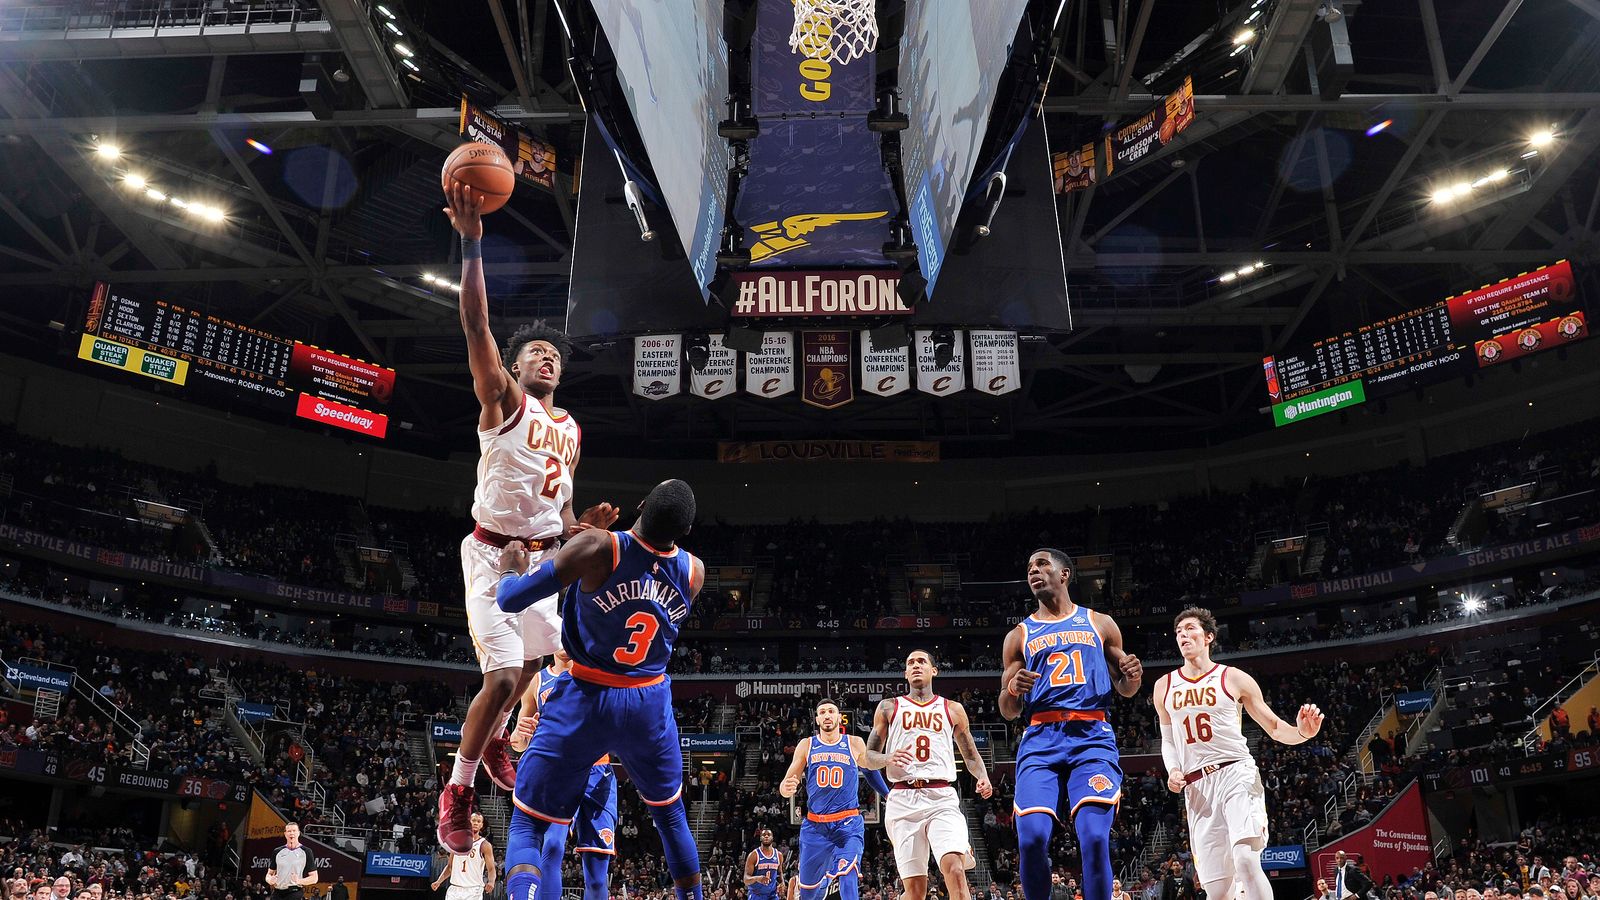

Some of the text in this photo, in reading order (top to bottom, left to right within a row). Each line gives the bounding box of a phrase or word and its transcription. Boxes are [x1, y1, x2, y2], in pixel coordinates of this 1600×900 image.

[797, 0, 832, 101] GOOD
[1123, 122, 1154, 145] ALL-STAR
[1117, 130, 1160, 160] CLARKSON'S
[1129, 146, 1151, 162] CREW
[916, 184, 940, 277] FirstEnergy
[1486, 286, 1513, 299] REQUIRE
[1513, 274, 1550, 290] ASSISTANCE
[120, 298, 140, 308] OSMAN
[1474, 306, 1488, 315] TEXT
[1523, 290, 1541, 299] TEAM
[119, 305, 134, 314] HOOD
[117, 312, 139, 323] SEXTON
[1490, 312, 1510, 322] TWEET
[114, 326, 132, 336] NANCE
[116, 319, 145, 332] CLARKSON
[119, 336, 140, 346] TOTALS
[641, 340, 675, 348] 2006-07
[763, 337, 787, 345] 15-16
[974, 340, 1015, 348] CHAMPIONS
[94, 342, 128, 354] QUAKER
[708, 350, 729, 358] STERN
[756, 347, 785, 355] ASTERN
[819, 346, 835, 354] NBA
[100, 350, 123, 360] STEAK
[104, 357, 120, 365] LUBE
[642, 351, 673, 359] EASTERN
[749, 356, 792, 365] CONFERENCE
[806, 354, 848, 363] CHAMPIONS
[864, 355, 906, 363] CONFERENCE
[144, 355, 175, 368] QUAKER
[316, 354, 328, 362] YOU
[327, 358, 349, 369] REQUIRE
[349, 364, 380, 378] ASSISTANCE
[636, 359, 678, 368] CONFERENCE
[707, 358, 735, 367] FERENCE
[1287, 361, 1306, 371] KANTER
[1410, 359, 1438, 373] RODNEY
[1439, 353, 1460, 365] HOOD
[149, 364, 171, 373] STEAK
[153, 370, 169, 378] LUBE
[637, 368, 676, 377] CHAMPIONS
[750, 366, 790, 375] CHAMPIONS
[866, 364, 905, 373] CHAMPIONS
[312, 365, 367, 385] TEXT THE TEAM
[238, 379, 265, 392] RODNEY
[266, 387, 286, 397] HOOD
[321, 379, 339, 389] TWEET
[1297, 390, 1353, 414] Huntington
[527, 419, 575, 466] CAVS
[759, 442, 886, 461] LOUDVILLE
[540, 457, 562, 500] 2
[66, 543, 92, 560] ALE
[1467, 542, 1542, 567] SCH-STYLE
[1546, 533, 1571, 550] ALE
[277, 585, 345, 606] SCH-STYLE
[348, 597, 372, 608] ALE
[592, 579, 687, 626] HARDAWAY JR
[1152, 606, 1167, 614] BKN
[747, 619, 763, 630] 101
[788, 620, 801, 629] 22
[816, 619, 840, 629] 4:45
[853, 618, 869, 630] 40
[916, 618, 931, 628] 95
[952, 617, 990, 627] FG% 45
[613, 611, 660, 667] 3
[1027, 631, 1097, 656] NEW YORK
[1047, 650, 1087, 688] 21
[18, 672, 69, 687] Cleveland Clinic
[1172, 687, 1217, 710] CAVS
[902, 711, 943, 733] CAVS
[1183, 712, 1213, 745] 16
[915, 735, 930, 762] 8
[811, 753, 851, 766] NEW YORK
[1553, 760, 1564, 768] 22
[1574, 751, 1592, 768] 95
[45, 764, 57, 775] 48
[1499, 766, 1511, 777] 40
[1520, 762, 1543, 774] 4:45
[87, 766, 106, 783] 45
[816, 766, 844, 788] 00
[1470, 768, 1489, 784] 101
[119, 773, 170, 790] REBOUNDS
[184, 779, 202, 796] 36
[234, 791, 246, 802] 45
[251, 826, 274, 836] PAINT THE
[1376, 829, 1427, 841] The Convenience
[1373, 840, 1429, 852] Stores of Speedwa
[1261, 849, 1300, 862] tEnergy
[372, 855, 427, 870] FirstEnergy
[461, 860, 467, 873] 1
